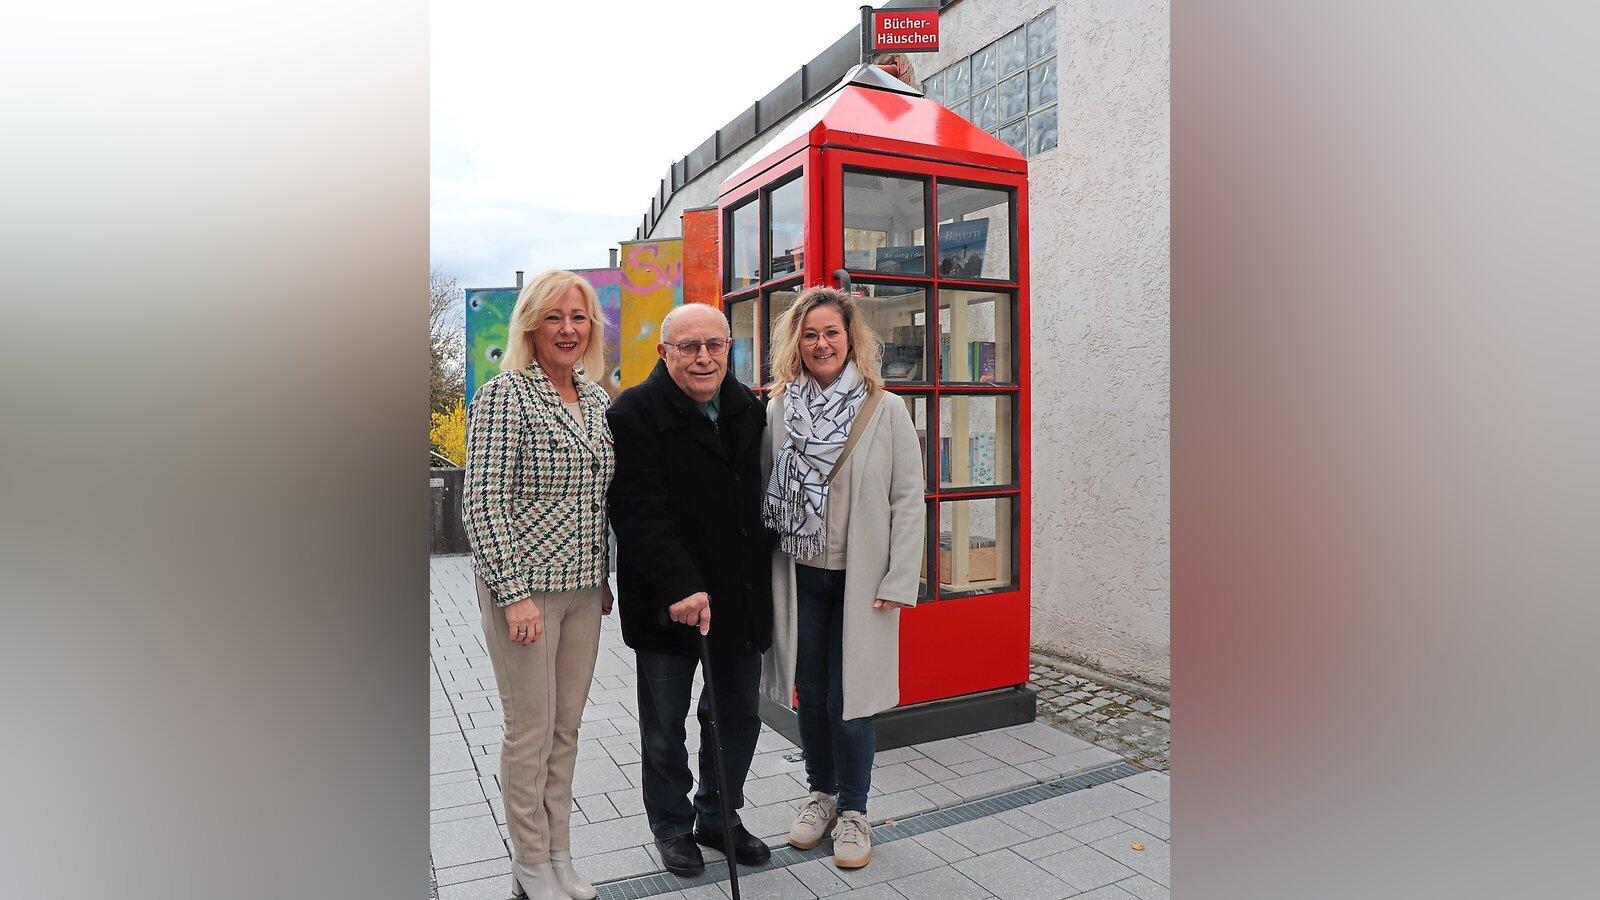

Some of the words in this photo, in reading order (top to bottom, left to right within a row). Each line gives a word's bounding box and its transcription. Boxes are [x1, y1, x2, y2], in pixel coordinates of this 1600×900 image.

[884, 17, 931, 29] Bücher-
[877, 32, 937, 44] Häuschen
[945, 230, 981, 243] Bayern
